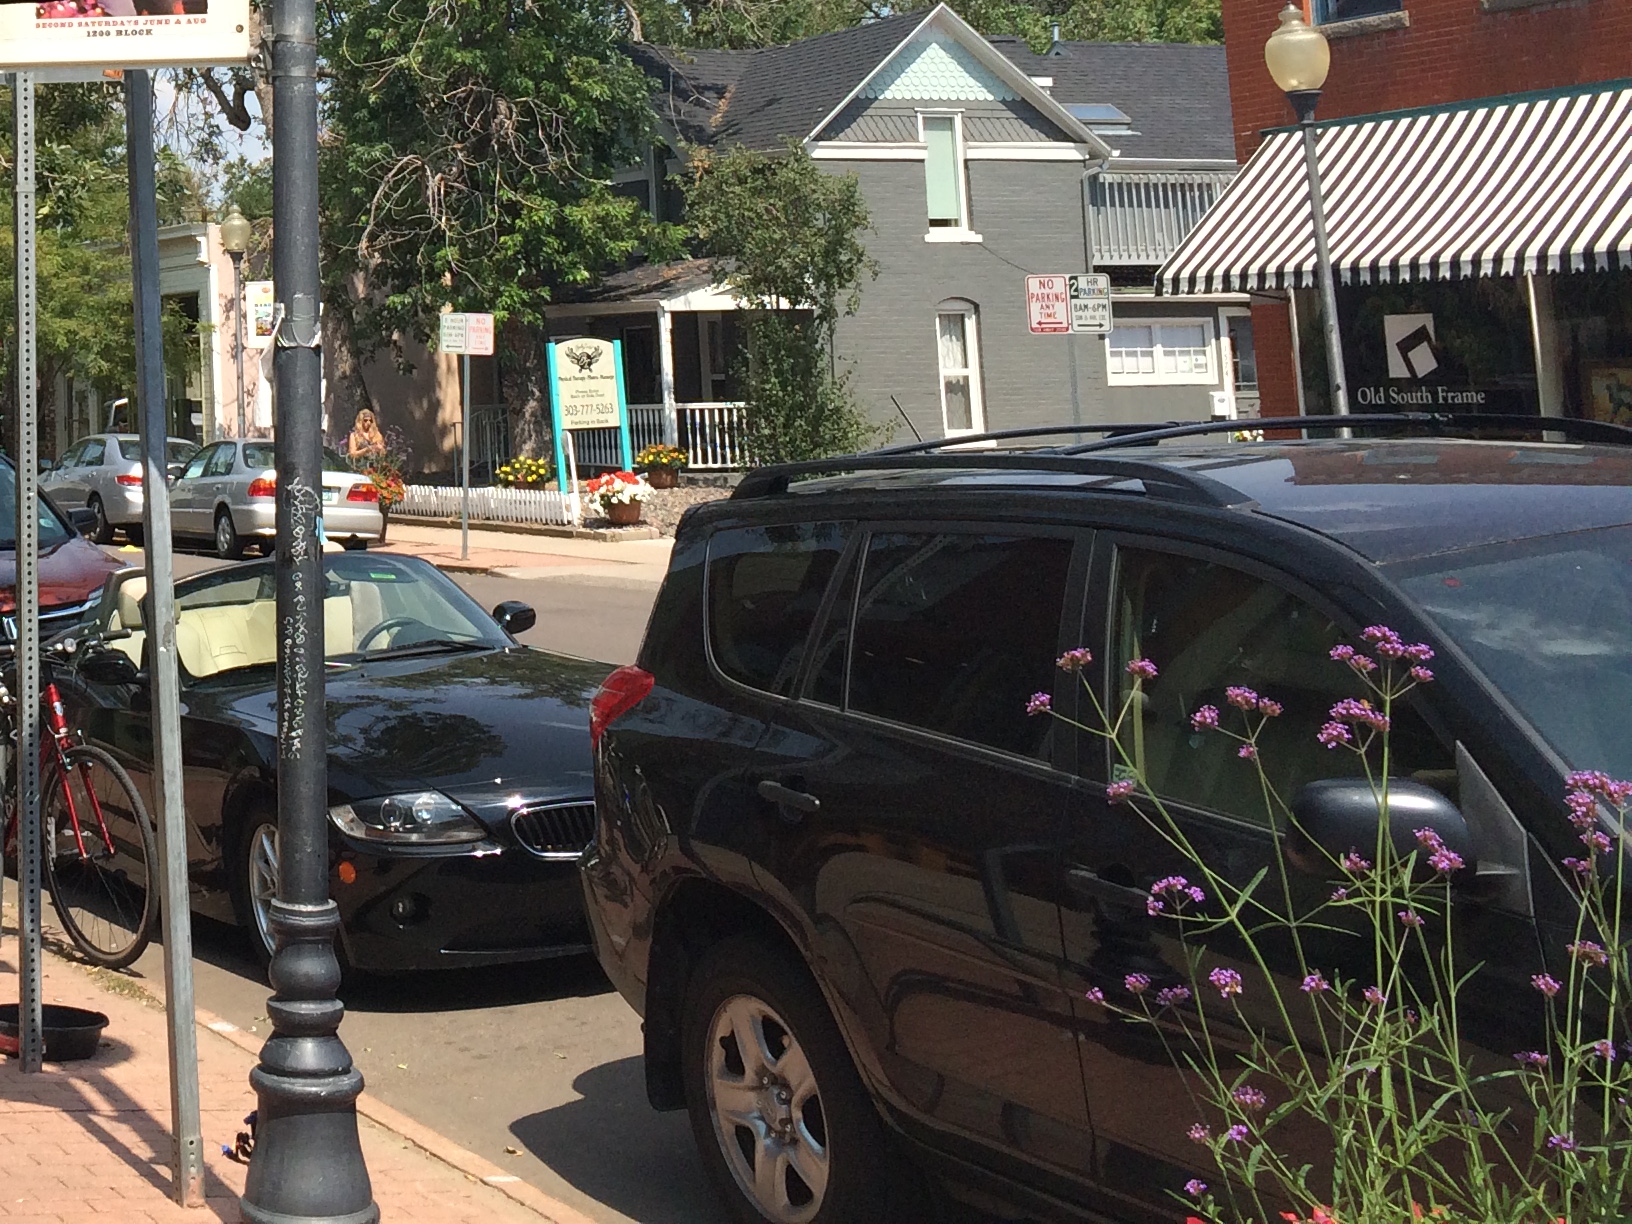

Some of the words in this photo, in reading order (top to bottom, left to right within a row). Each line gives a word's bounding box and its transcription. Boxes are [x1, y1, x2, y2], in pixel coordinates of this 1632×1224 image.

[35, 21, 74, 29] SECOND
[77, 19, 139, 27] SATURDAYS
[186, 17, 207, 25] AUG
[115, 28, 153, 37] BLOCK
[1038, 278, 1054, 290] NO
[1086, 277, 1099, 287] HR
[1069, 279, 1079, 296] 2
[1079, 287, 1108, 296] PARKING
[1030, 292, 1065, 303] PARKING
[1039, 303, 1055, 311] ANY
[1073, 303, 1108, 313] 8AM-6PM
[1039, 311, 1058, 319] TIME
[476, 317, 486, 325] NO
[1357, 386, 1386, 405] Old
[1389, 385, 1433, 405] South
[1436, 386, 1486, 404] Frame
